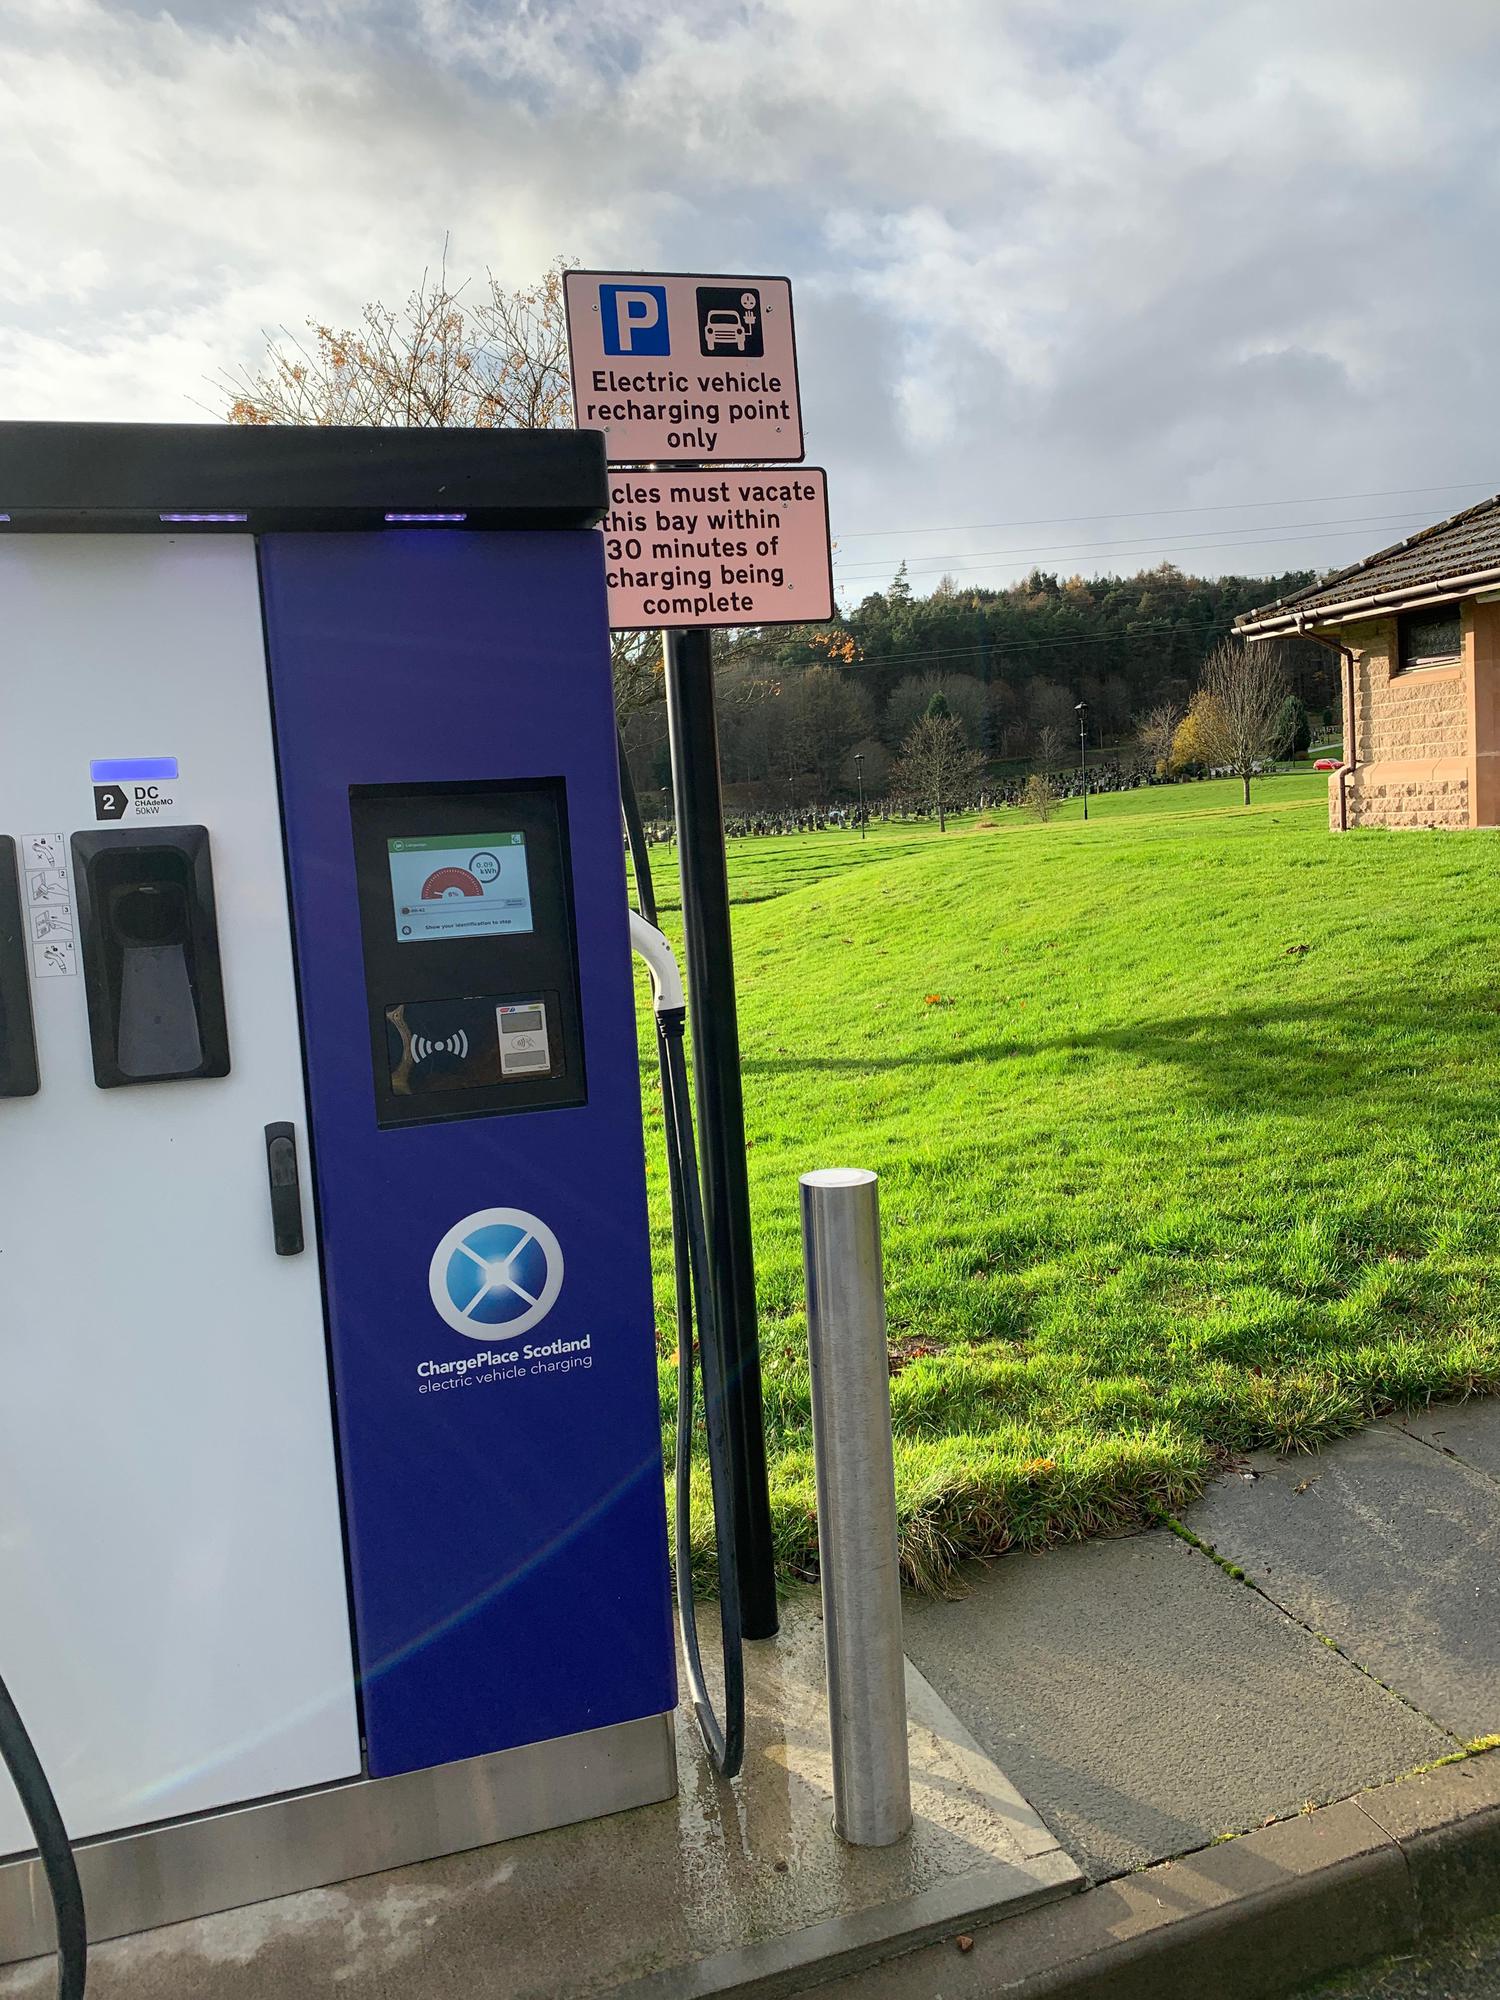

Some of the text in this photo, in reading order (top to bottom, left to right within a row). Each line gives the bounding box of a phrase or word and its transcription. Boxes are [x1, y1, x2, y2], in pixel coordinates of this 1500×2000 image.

[615, 291, 659, 351] P
[592, 371, 782, 392] Electric vehicle
[587, 399, 790, 424] recharging point
[667, 428, 718, 451] only
[611, 481, 816, 504] cles must vacate
[602, 509, 780, 534] this bay within
[606, 536, 779, 559] 30 minutes of
[606, 564, 784, 591] charging being
[643, 592, 754, 617] complete
[103, 794, 116, 810] 2
[134, 786, 159, 800] DC
[134, 798, 173, 807] CHAdeMO
[135, 806, 160, 815] 50kW
[416, 1334, 591, 1377] ChargePlace Scotland
[418, 1354, 593, 1394] electric vehicle charging
